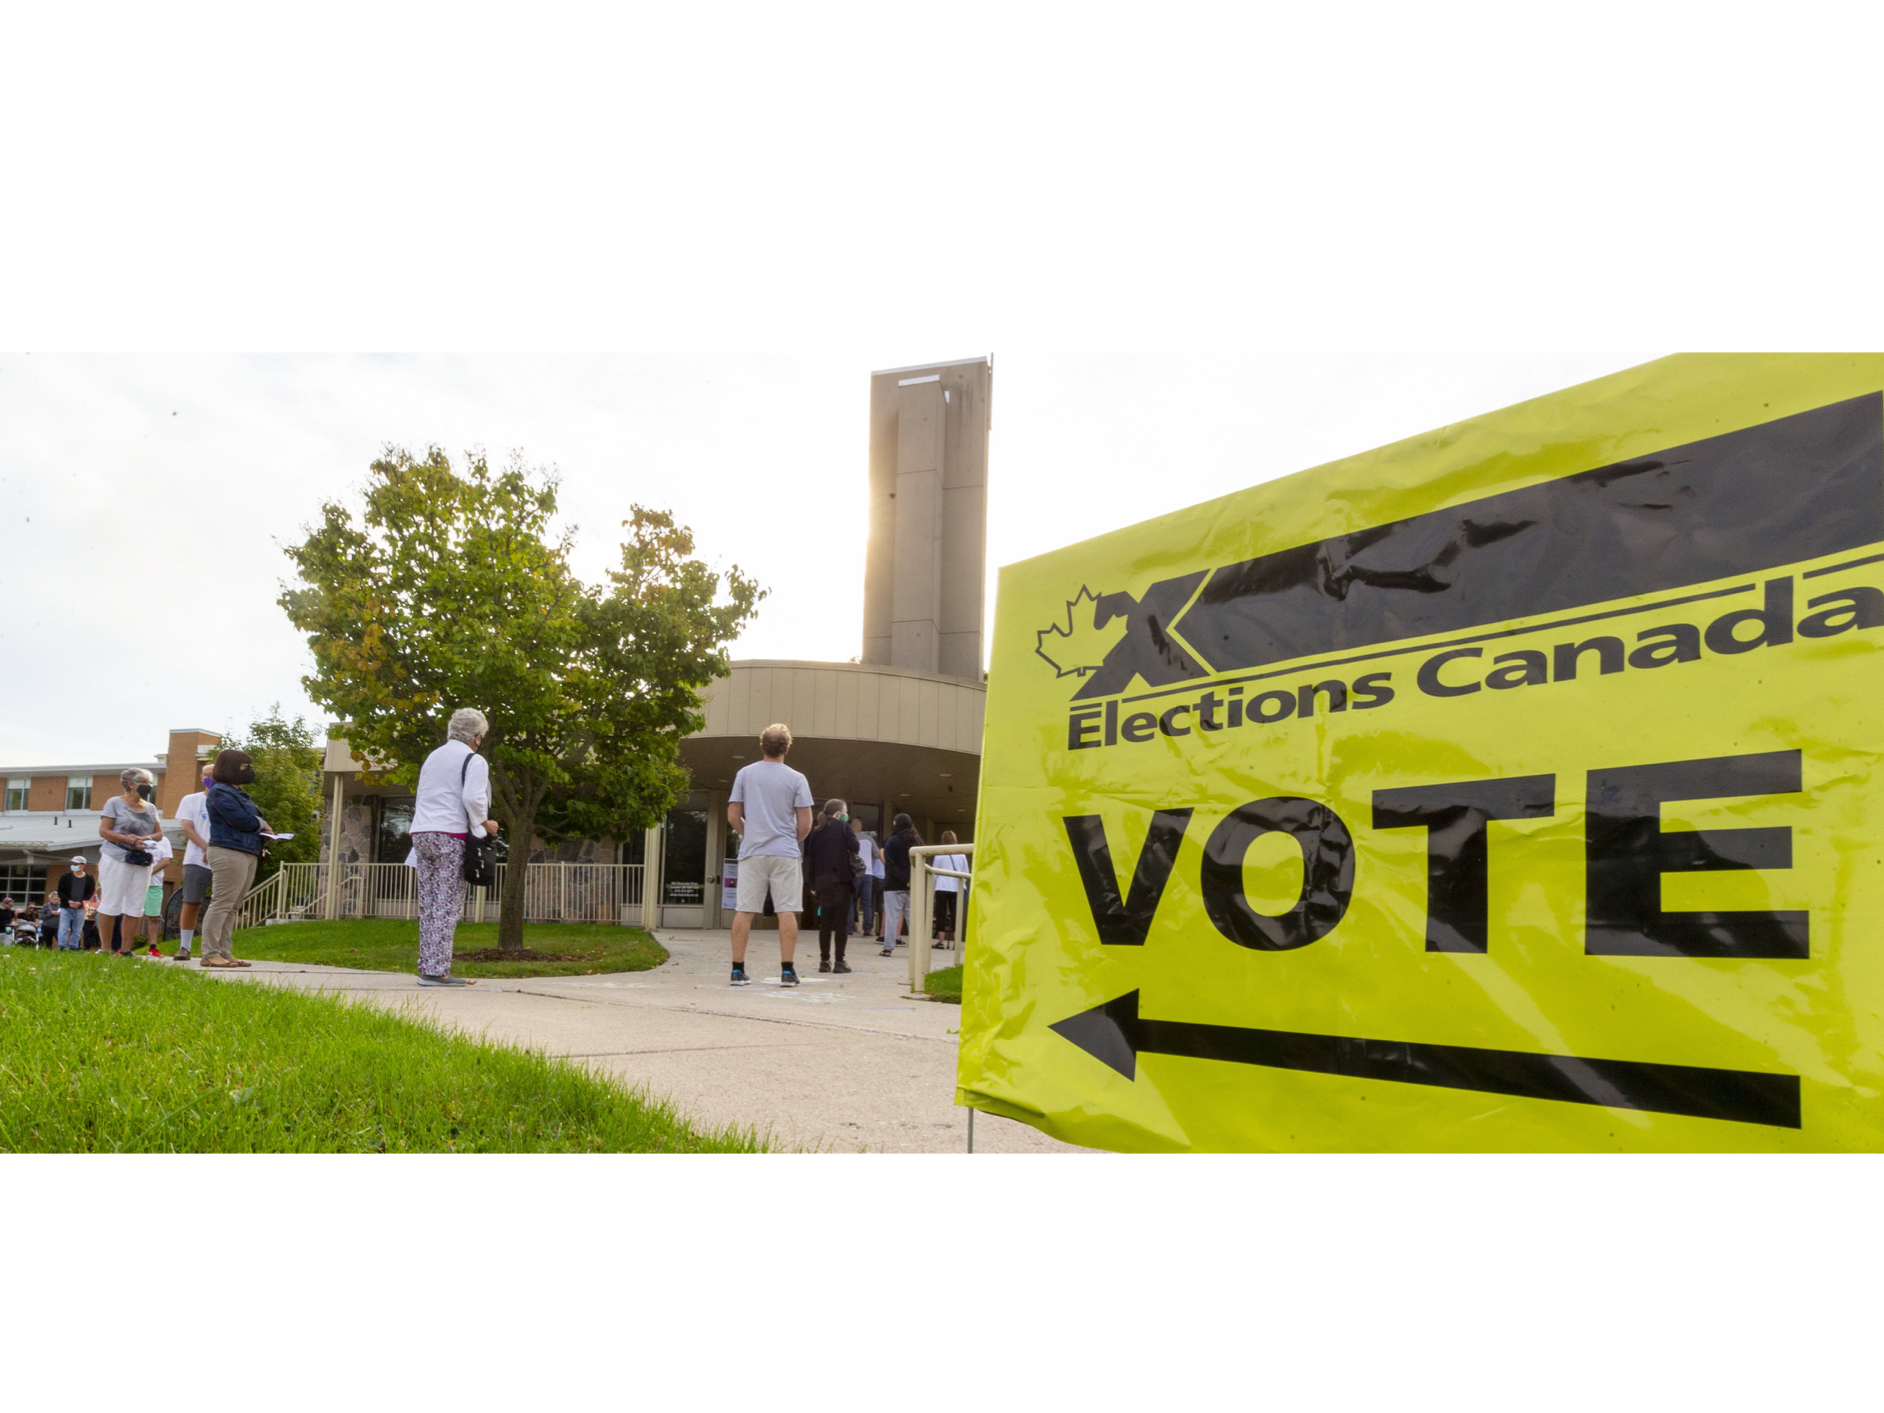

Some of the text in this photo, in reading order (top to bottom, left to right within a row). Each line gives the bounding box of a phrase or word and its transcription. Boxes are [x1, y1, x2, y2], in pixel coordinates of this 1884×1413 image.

[1068, 575, 1884, 750] Elections Canada
[1062, 749, 1810, 960] VOTE
